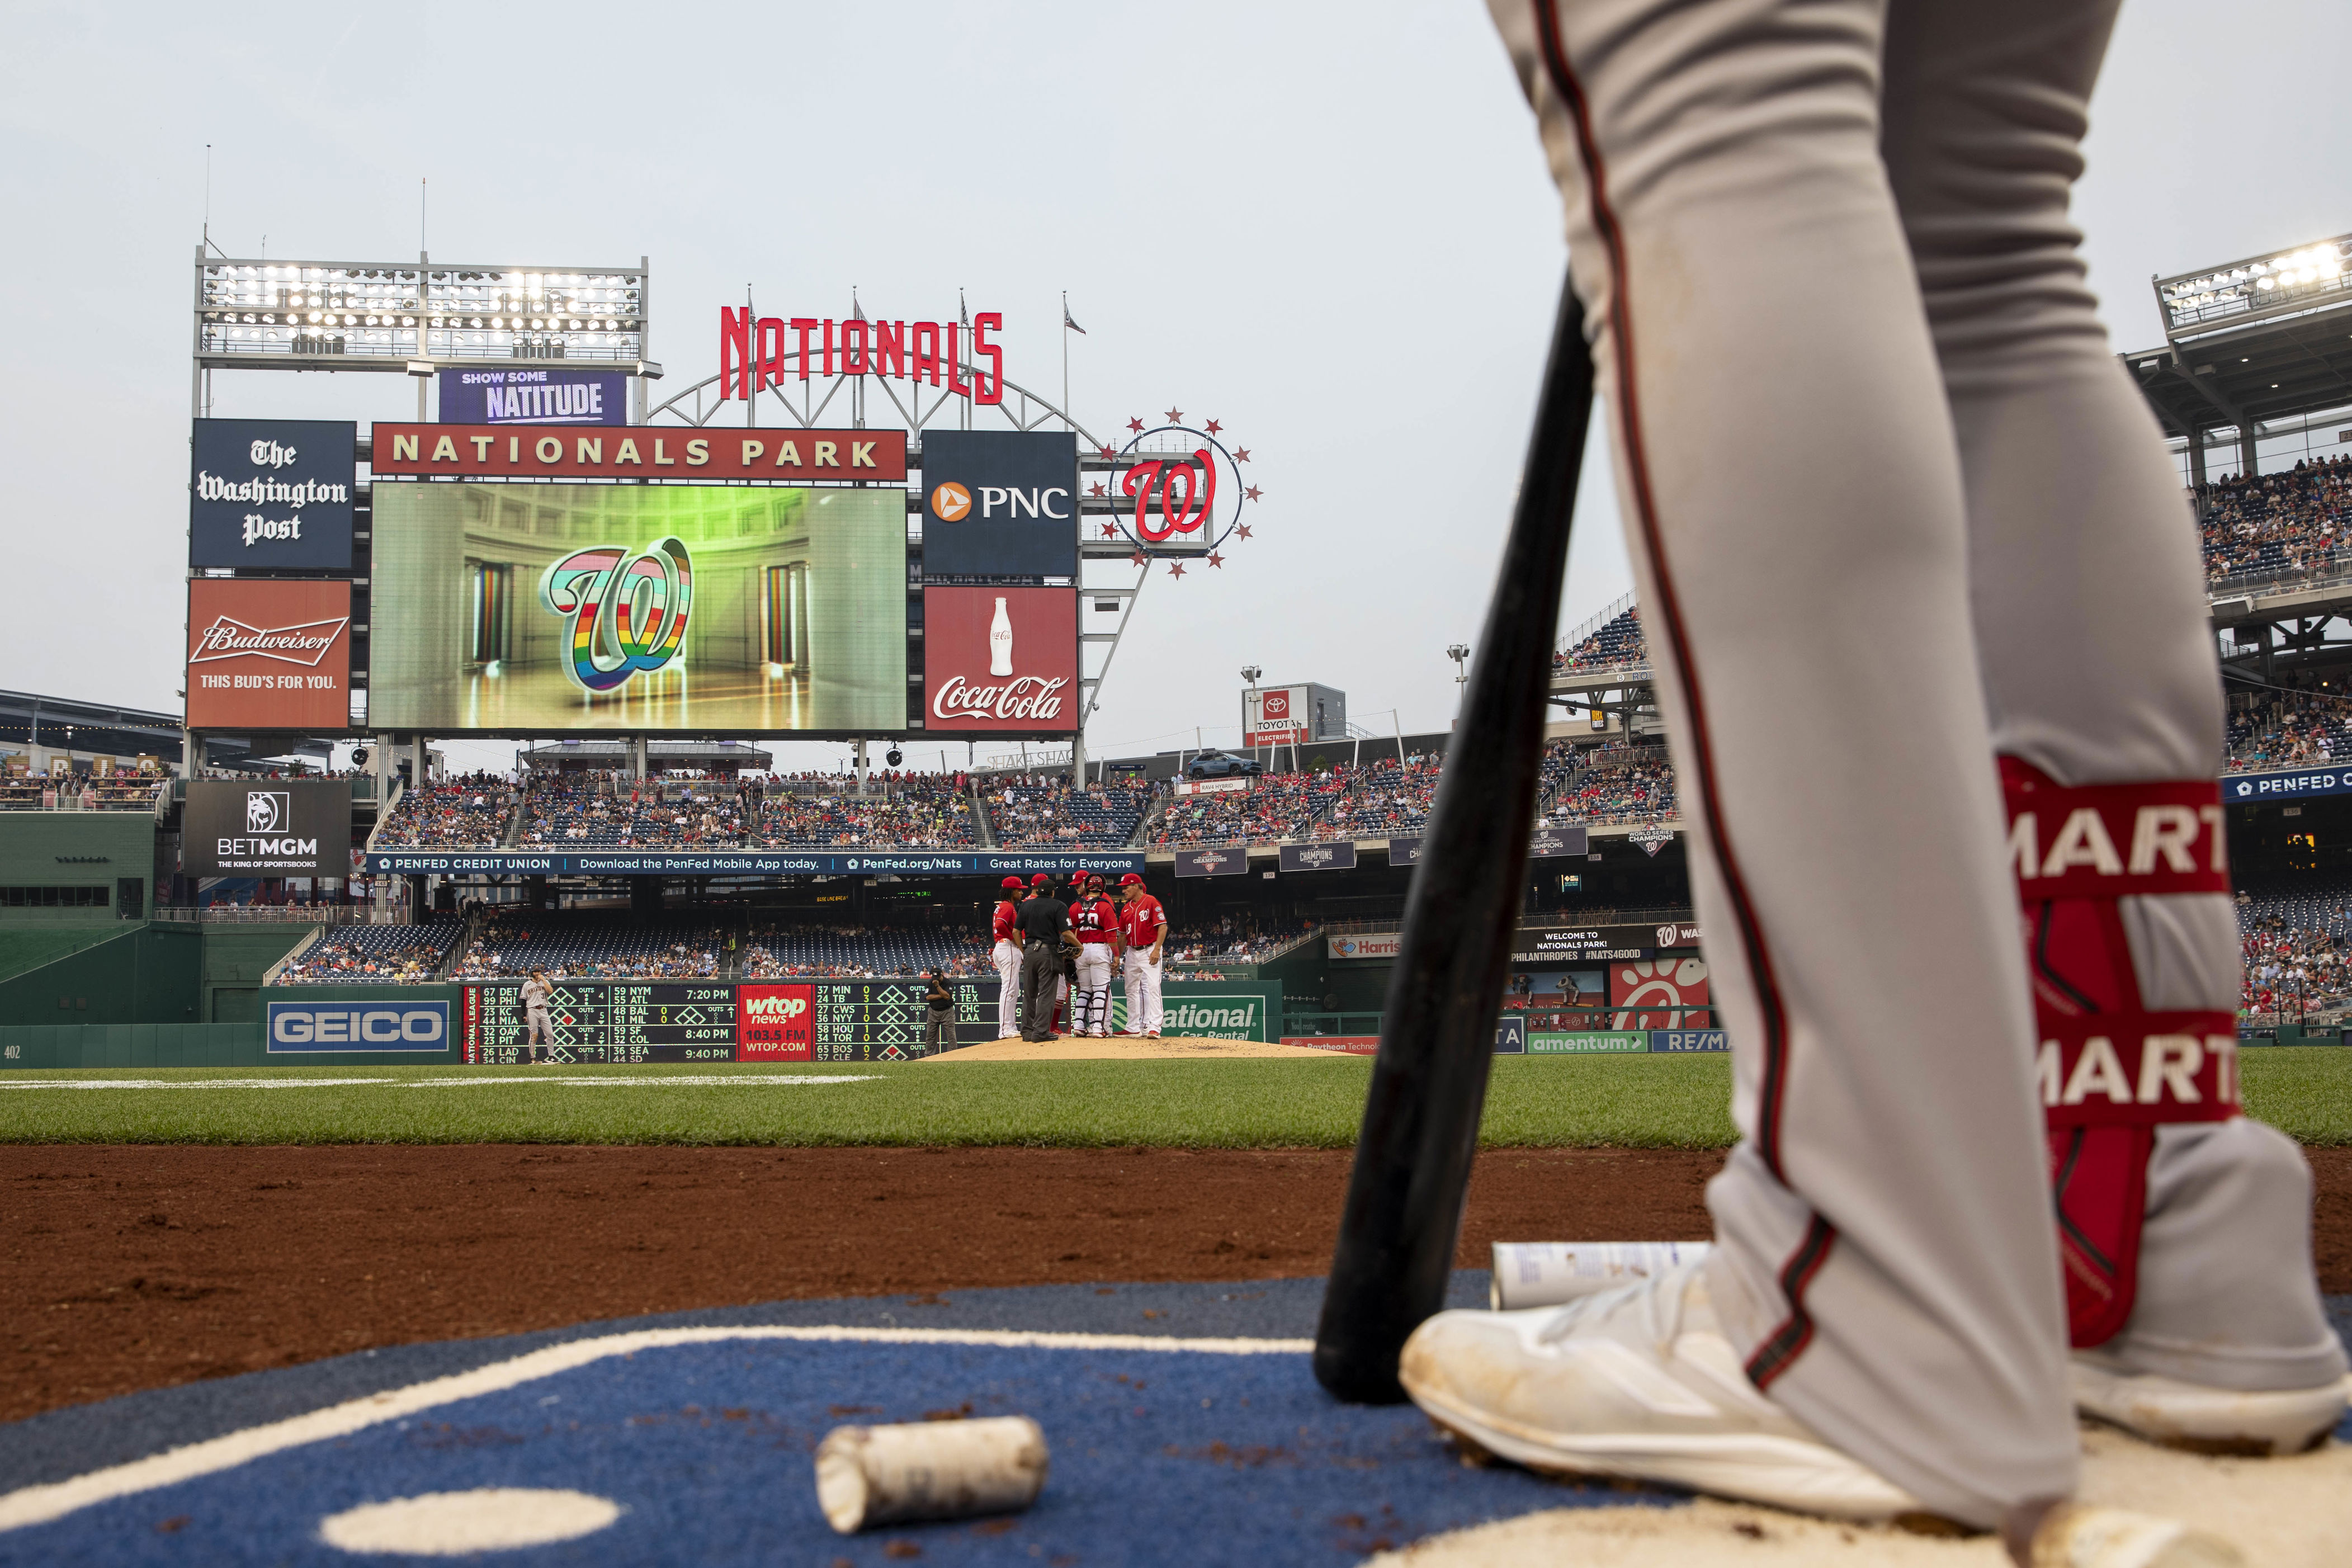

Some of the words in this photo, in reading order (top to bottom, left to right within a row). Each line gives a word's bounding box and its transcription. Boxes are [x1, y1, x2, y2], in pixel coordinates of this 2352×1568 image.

[721, 306, 1003, 405] NATIONALS
[462, 373, 504, 384] SHOW
[508, 371, 547, 382] SOME
[487, 383, 602, 418] NATITUDE
[251, 440, 297, 469] The
[393, 434, 709, 465] NATIONALS
[743, 441, 877, 466] PARK
[197, 470, 348, 509] Washington
[983, 488, 1069, 519] PNC
[242, 513, 301, 547] Post
[204, 626, 331, 650] Budweiser
[201, 675, 230, 688] THIS
[234, 675, 274, 688] BUD'S
[278, 676, 303, 689] FOR
[307, 676, 337, 689] YOU.
[933, 676, 1069, 720] Coca-Cola
[1258, 720, 1296, 730] TOYOTA
[2259, 775, 2336, 793] PENFED
[217, 839, 317, 856] BETMGM
[1300, 850, 1333, 862] CHAMPIONS
[395, 859, 448, 869] PENFED
[454, 859, 502, 868] CREDIT
[507, 859, 550, 868] UNION
[580, 859, 640, 868] Download
[643, 859, 662, 868] the
[665, 859, 709, 868] PenFed
[714, 859, 752, 868] Mobile
[755, 859, 780, 870] App
[783, 859, 819, 871] today.
[863, 858, 962, 870] PenFed.org/Nats
[990, 859, 1021, 868] Great
[1025, 859, 1056, 868] Rates
[1060, 858, 1075, 868] for
[1080, 859, 1132, 871] Everyone
[1545, 932, 1585, 940] WELCOME
[1359, 940, 1401, 954] Harris
[1511, 951, 1578, 962] PHILANTHROPIES
[1586, 949, 1640, 960] #NATS4GOOD
[484, 988, 495, 996] 67
[500, 988, 518, 996] DET
[528, 986, 545, 995] ARIZON
[687, 990, 710, 999] 7:20
[714, 990, 729, 999] PM
[960, 994, 979, 1002] TEX
[484, 1008, 495, 1016] 23
[500, 1008, 512, 1016] KC
[746, 996, 806, 1018] wtop
[751, 1014, 787, 1024] news
[1161, 1004, 1254, 1028] ational
[274, 1011, 443, 1043] GEICO
[686, 1029, 710, 1038] 8:40
[713, 1029, 729, 1038] PM
[500, 1036, 514, 1045] PIT
[746, 1030, 781, 1040] 103.5
[786, 1030, 805, 1040] FM
[746, 1043, 805, 1051] WTOP.COM
[1533, 1036, 1628, 1051] amentum
[4, 1045, 20, 1059] 402
[713, 1049, 729, 1058] PM
